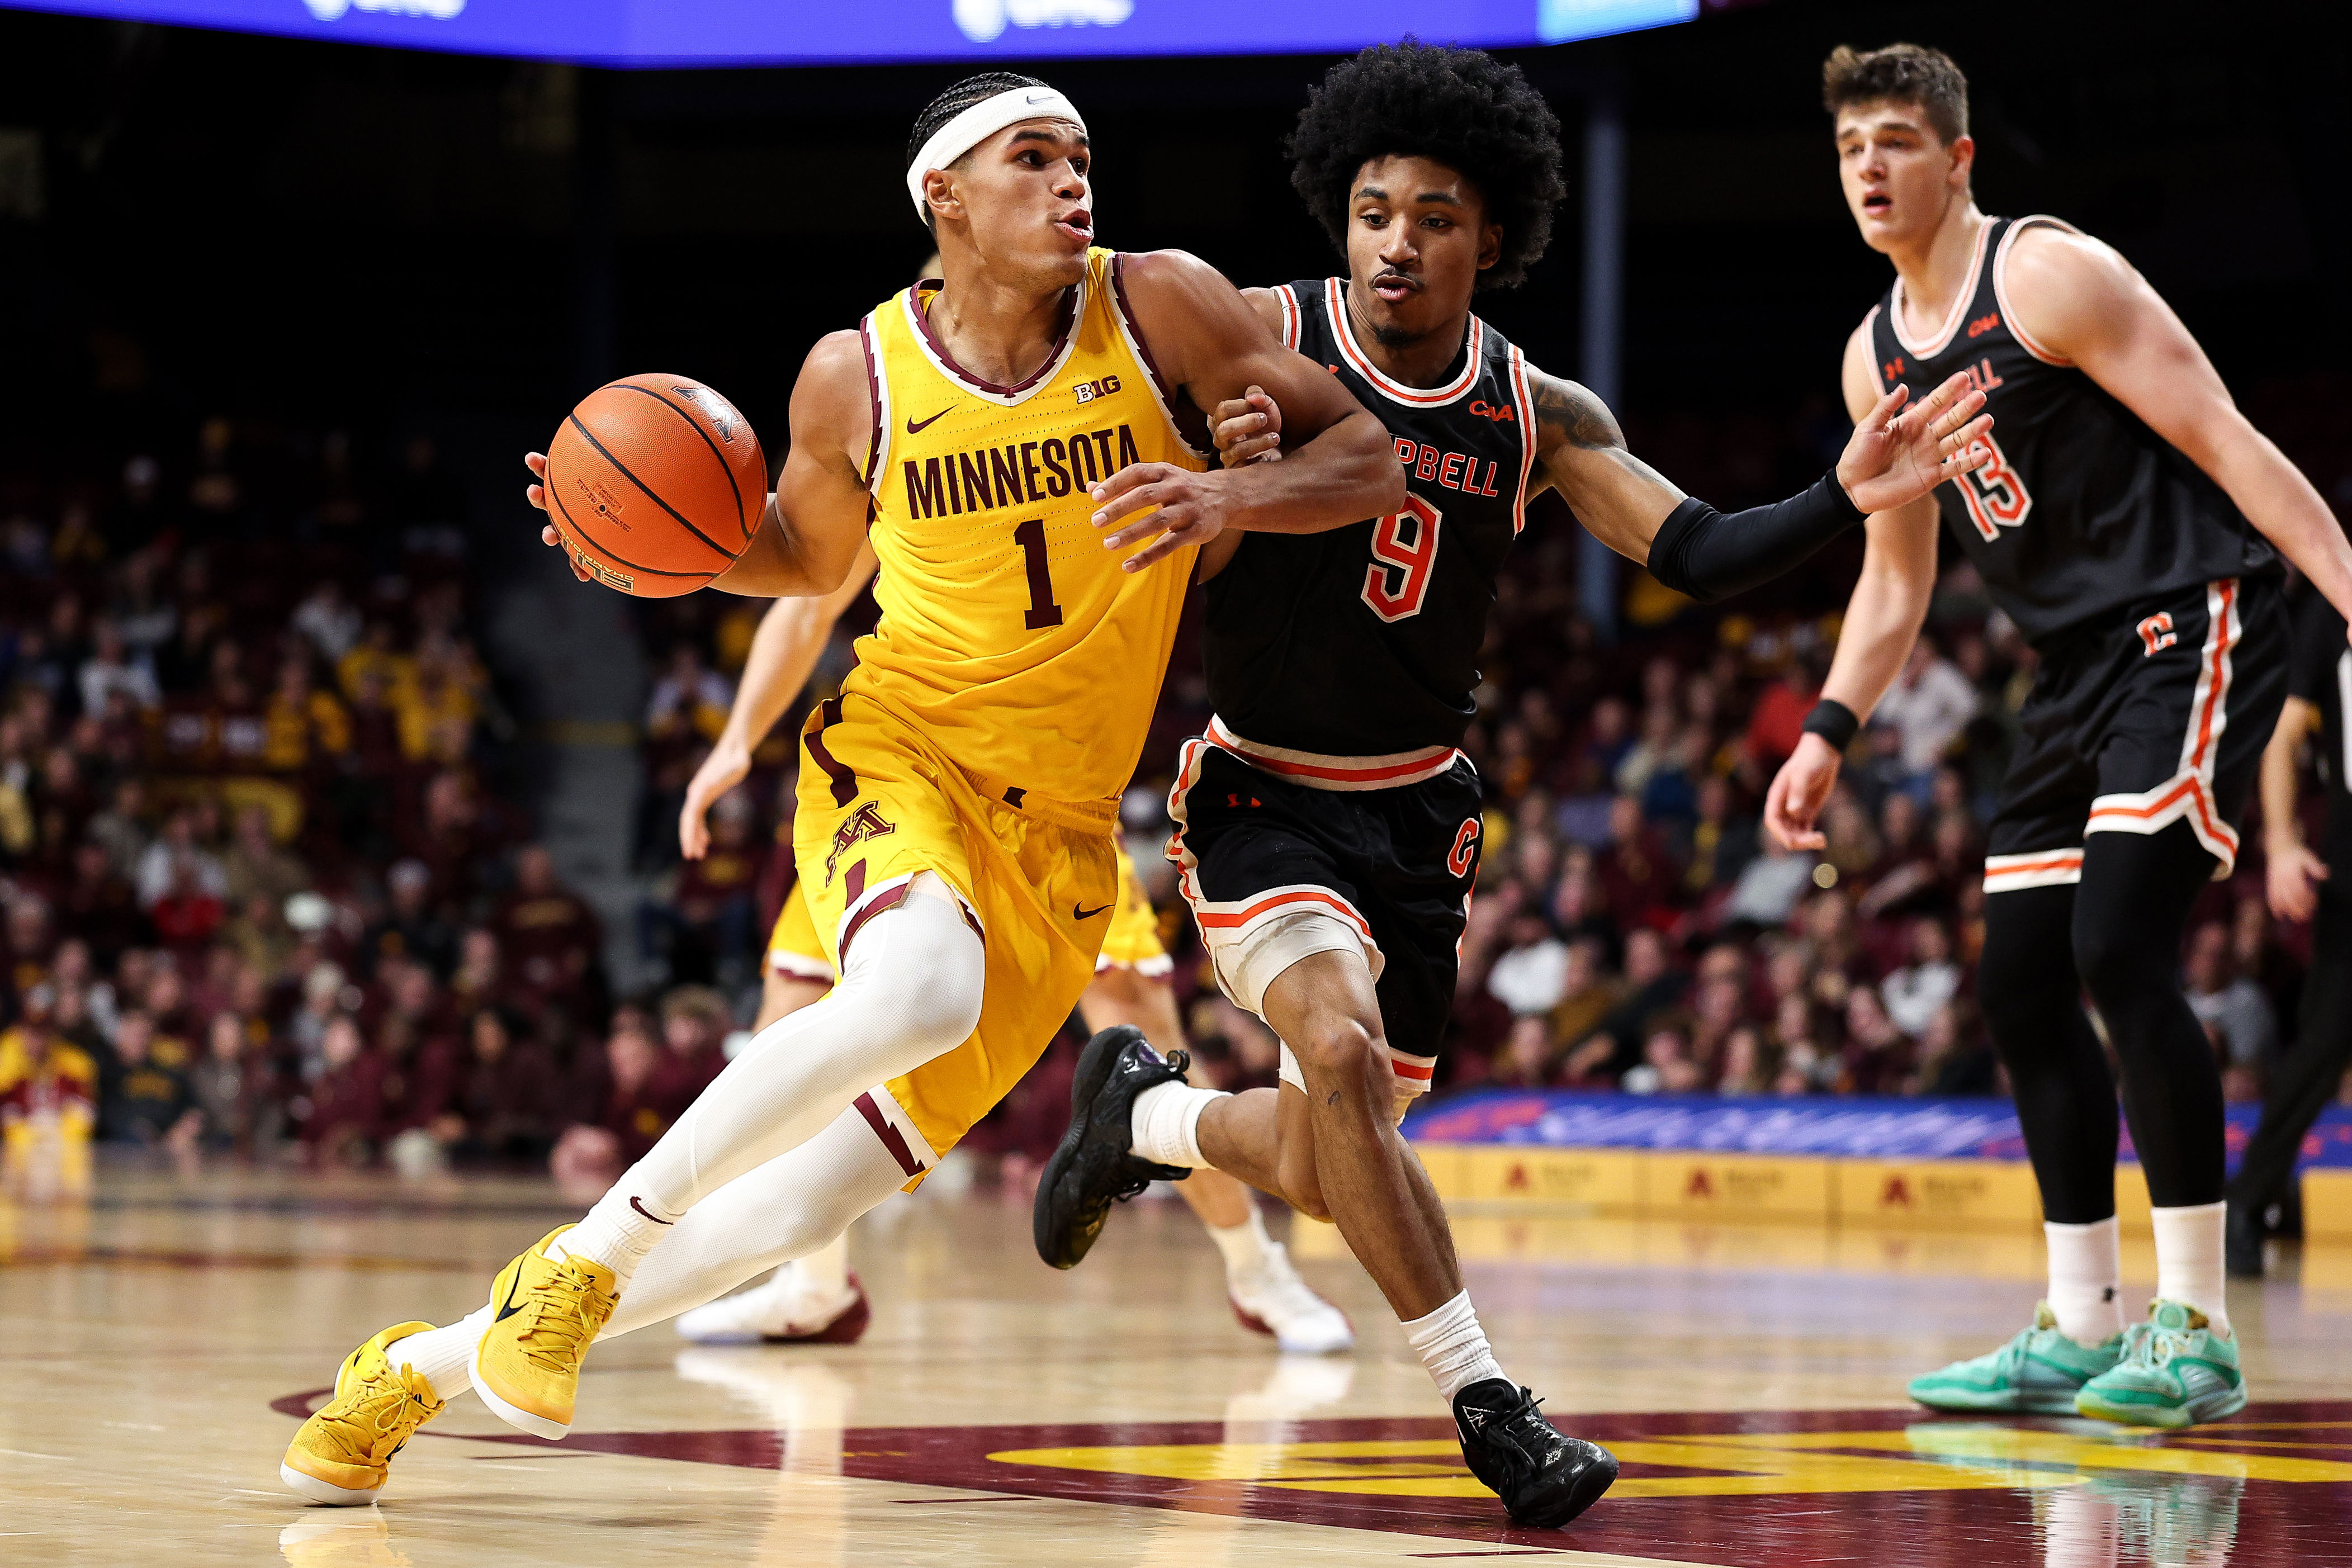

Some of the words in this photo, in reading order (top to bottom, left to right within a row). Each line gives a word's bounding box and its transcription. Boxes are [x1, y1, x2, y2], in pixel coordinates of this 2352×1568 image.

[904, 424, 1140, 520] MINNESOTA
[1394, 438, 1498, 498] PBELL
[1946, 431, 2033, 543] 13
[557, 523, 635, 581] CHAMPIONS
[1014, 519, 1063, 630] 1
[1361, 491, 1443, 623] 9
[2136, 612, 2178, 657] C
[825, 800, 896, 888] M
[1447, 817, 1479, 879] C
